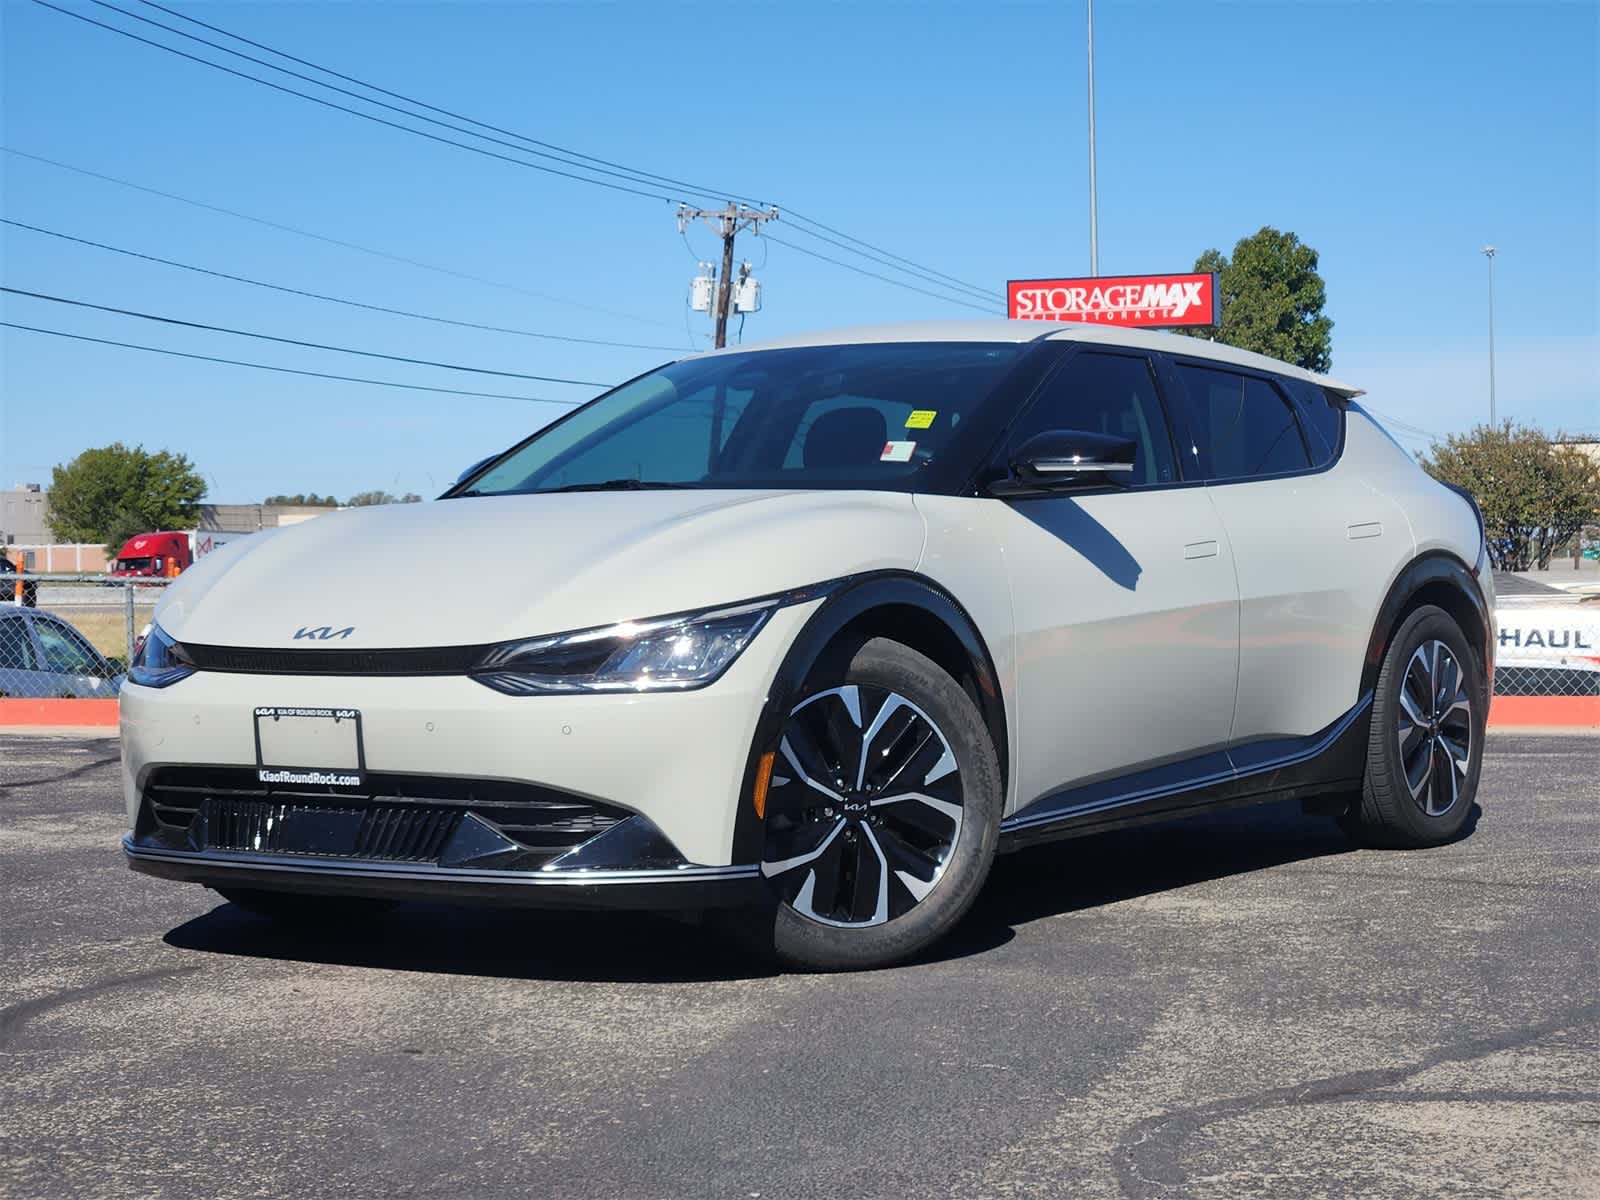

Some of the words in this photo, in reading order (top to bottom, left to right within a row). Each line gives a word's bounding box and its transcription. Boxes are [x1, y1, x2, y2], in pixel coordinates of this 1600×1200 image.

[1015, 282, 1204, 317] STORAGEMAX
[1081, 309, 1169, 321] STORAGE
[293, 626, 355, 640] KIA
[259, 769, 360, 786] KiaofRoundRock.com
